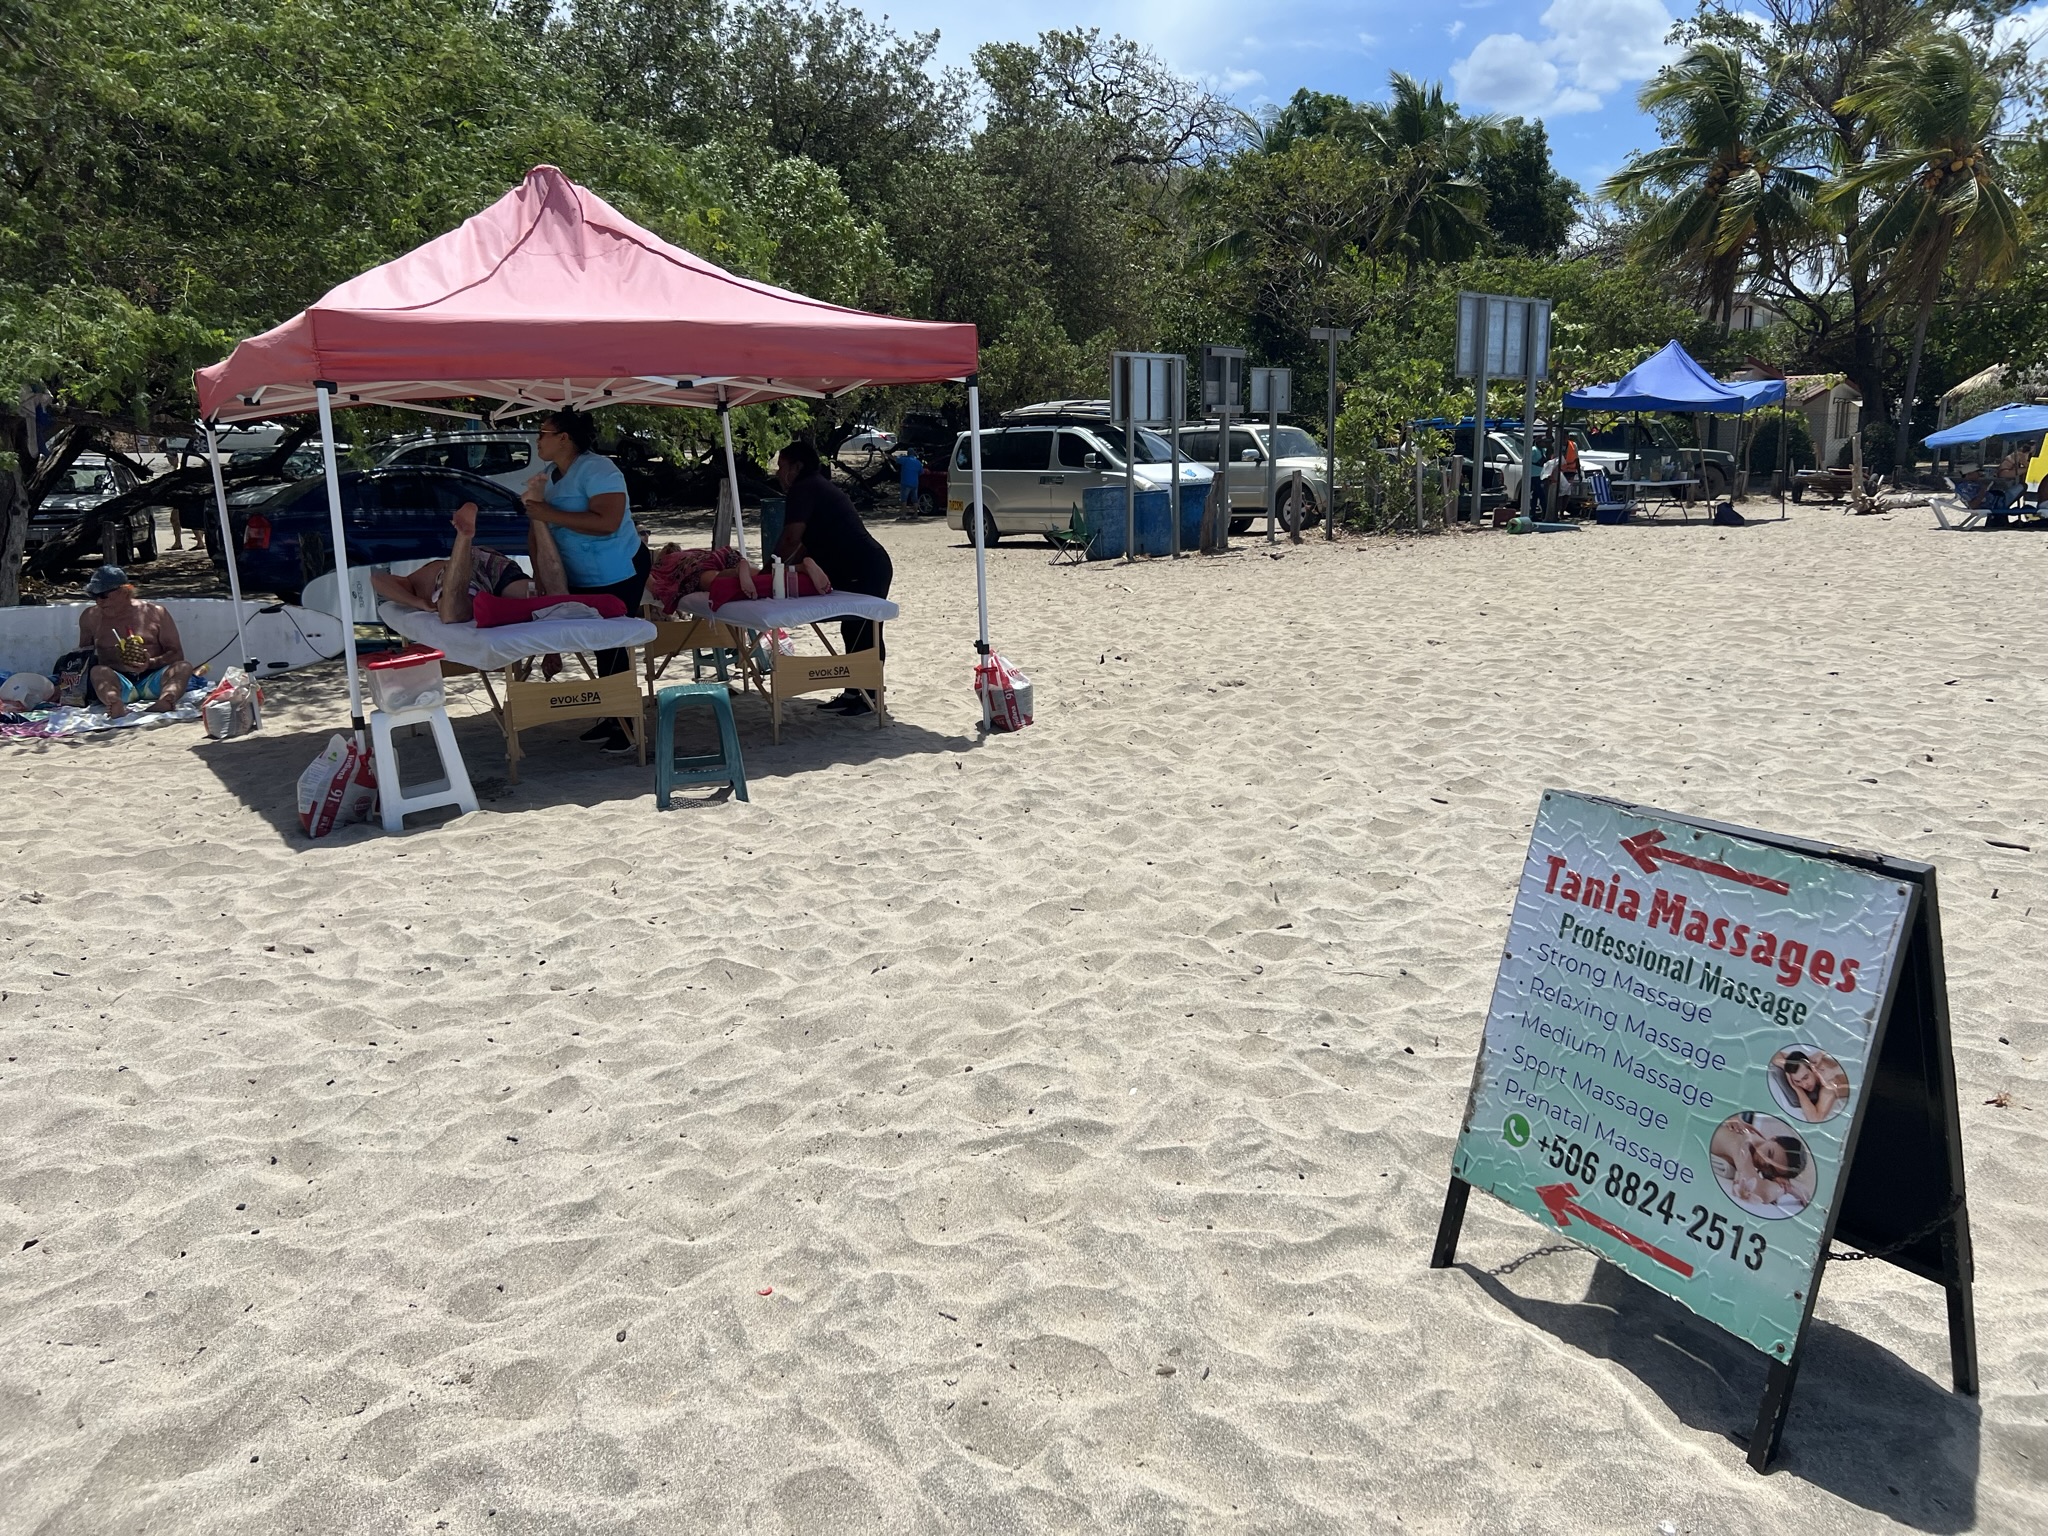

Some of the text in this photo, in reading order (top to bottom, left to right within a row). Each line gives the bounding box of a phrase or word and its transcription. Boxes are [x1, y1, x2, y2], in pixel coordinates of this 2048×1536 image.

[580, 691, 601, 702] SPA
[833, 666, 851, 676] SPA
[327, 788, 343, 803] 91
[1545, 854, 1861, 993] Tania Massages
[1558, 912, 1808, 1026] Professional Massage
[1529, 976, 1726, 1071] Relaxing Massage
[1536, 943, 1713, 1023] Strong Massage
[1512, 1045, 1669, 1130] Sport Massage
[1521, 1010, 1714, 1108] Medium Massage
[1504, 1078, 1695, 1184] Prenatal Massage
[1537, 1134, 1767, 1272] +506 8824-2513
